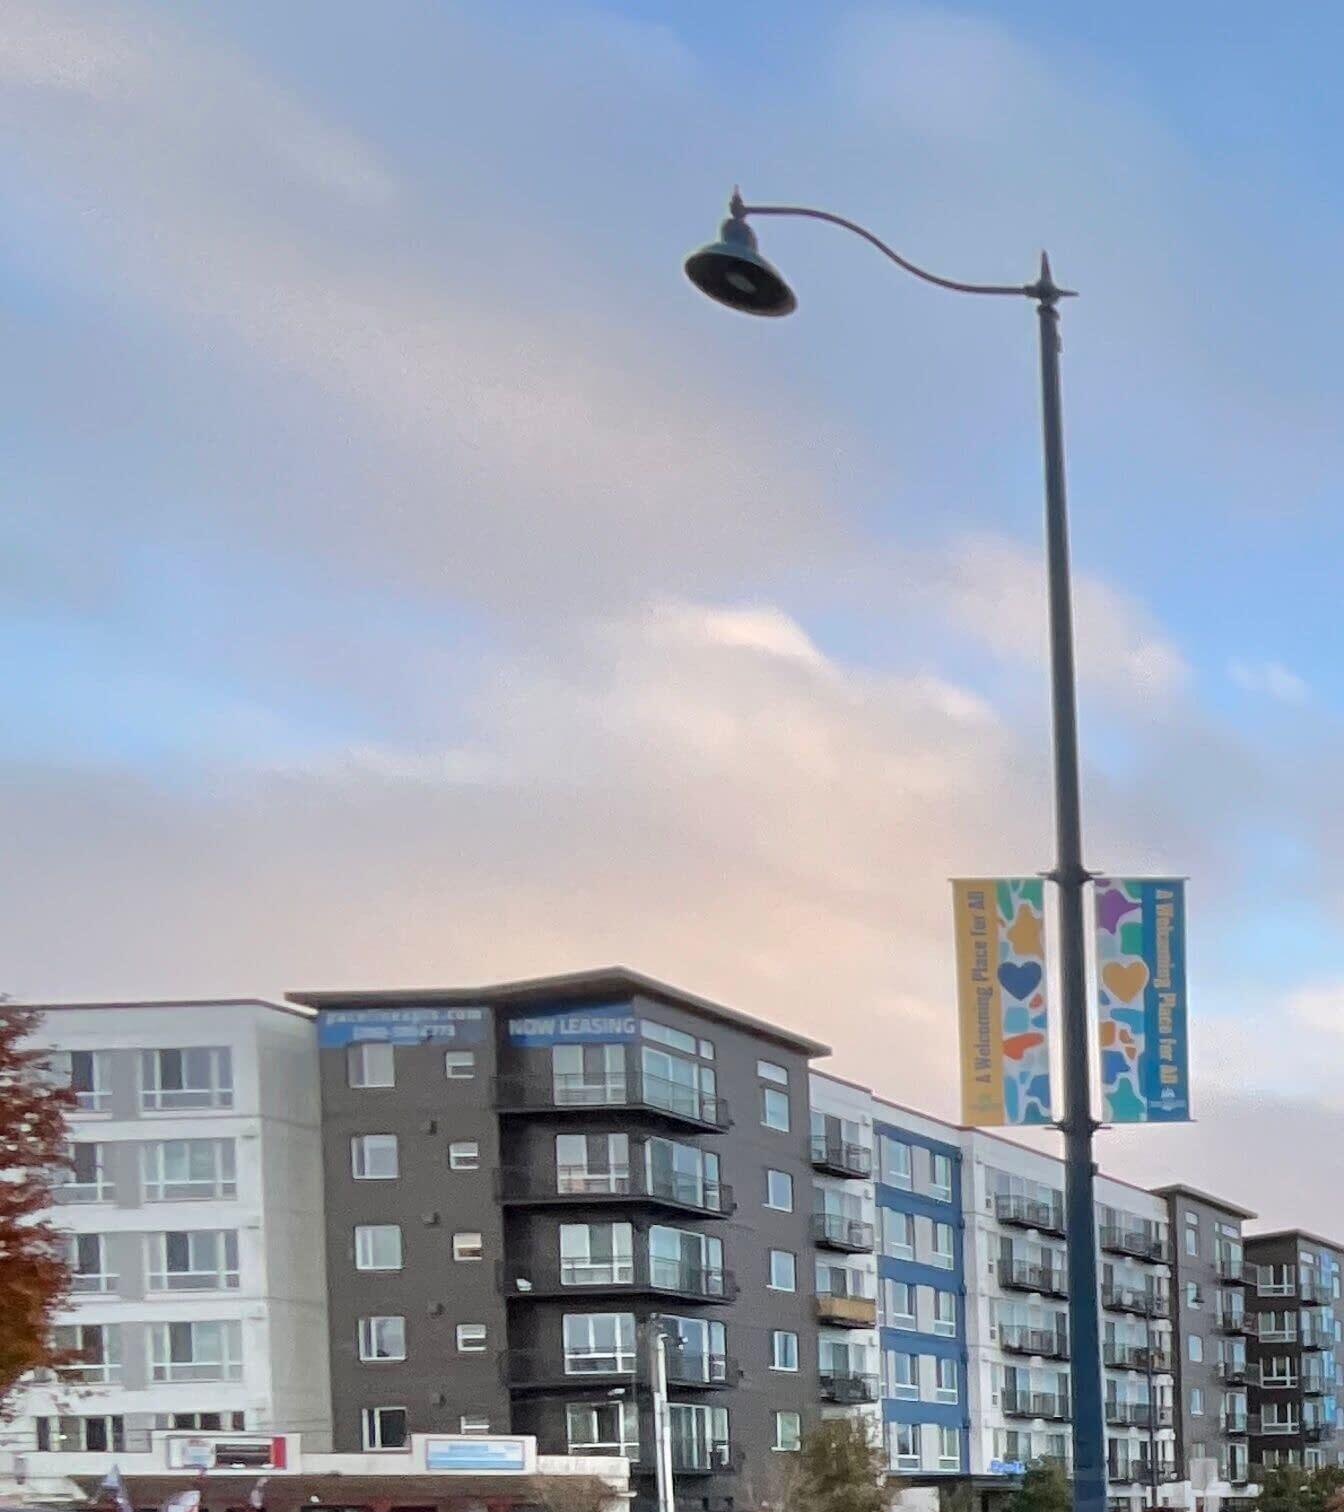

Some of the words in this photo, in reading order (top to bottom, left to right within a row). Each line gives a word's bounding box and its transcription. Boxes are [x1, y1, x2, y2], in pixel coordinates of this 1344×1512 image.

[971, 942, 988, 982] Place
[509, 1018, 555, 1036] NOW
[559, 1016, 636, 1035] LEASING
[974, 986, 993, 1070] Welcoming
